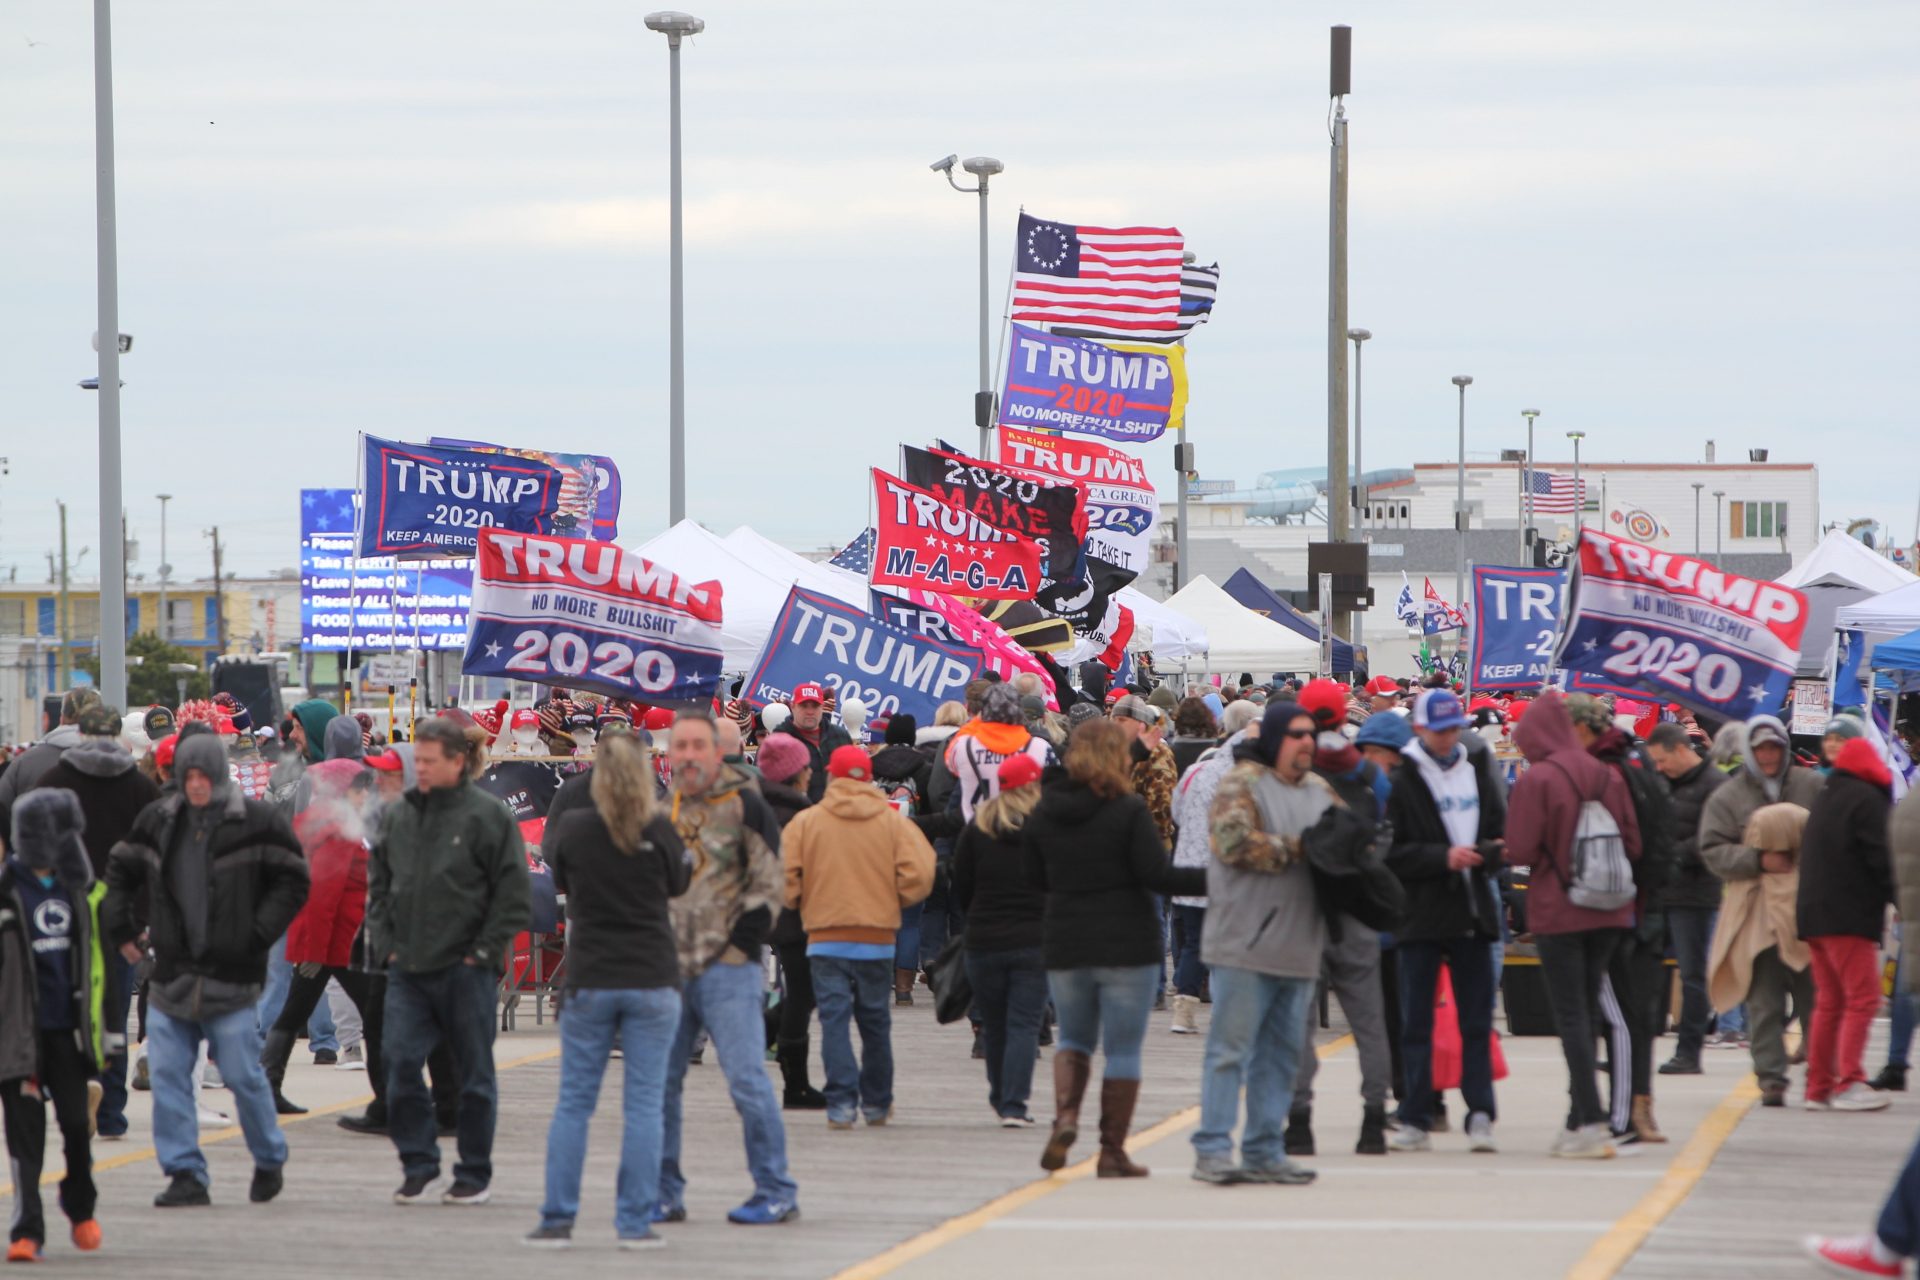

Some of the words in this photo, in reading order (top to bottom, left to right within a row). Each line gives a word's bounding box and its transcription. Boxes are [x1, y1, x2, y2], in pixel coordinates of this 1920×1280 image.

[1020, 338, 1169, 391] TRUMP
[1009, 403, 1035, 418] NO
[1035, 410, 1083, 426] MORE
[1055, 383, 1126, 417] 2020
[390, 458, 540, 504] TRUMP
[945, 458, 1039, 504] 2020
[886, 481, 1018, 543] TRUM
[931, 483, 1052, 535] MAKE
[386, 530, 420, 542] KEEP
[423, 532, 477, 548] AMERIC
[1097, 540, 1119, 567] TAKE
[385, 576, 407, 589] ON
[884, 546, 1029, 593] M-A-G-A
[1581, 529, 1800, 625] TRUMP
[362, 595, 391, 609] ALL
[531, 594, 548, 611] NO
[554, 594, 598, 618] MORE
[606, 605, 678, 635] BULLSHIT
[1632, 594, 1650, 612] NO
[504, 629, 676, 692] 2020
[791, 599, 971, 699] TRUMP
[1601, 629, 1742, 703] 2020
[1481, 663, 1524, 678] KEEP
[801, 687, 819, 698] USA
[975, 749, 1008, 765] TRU
